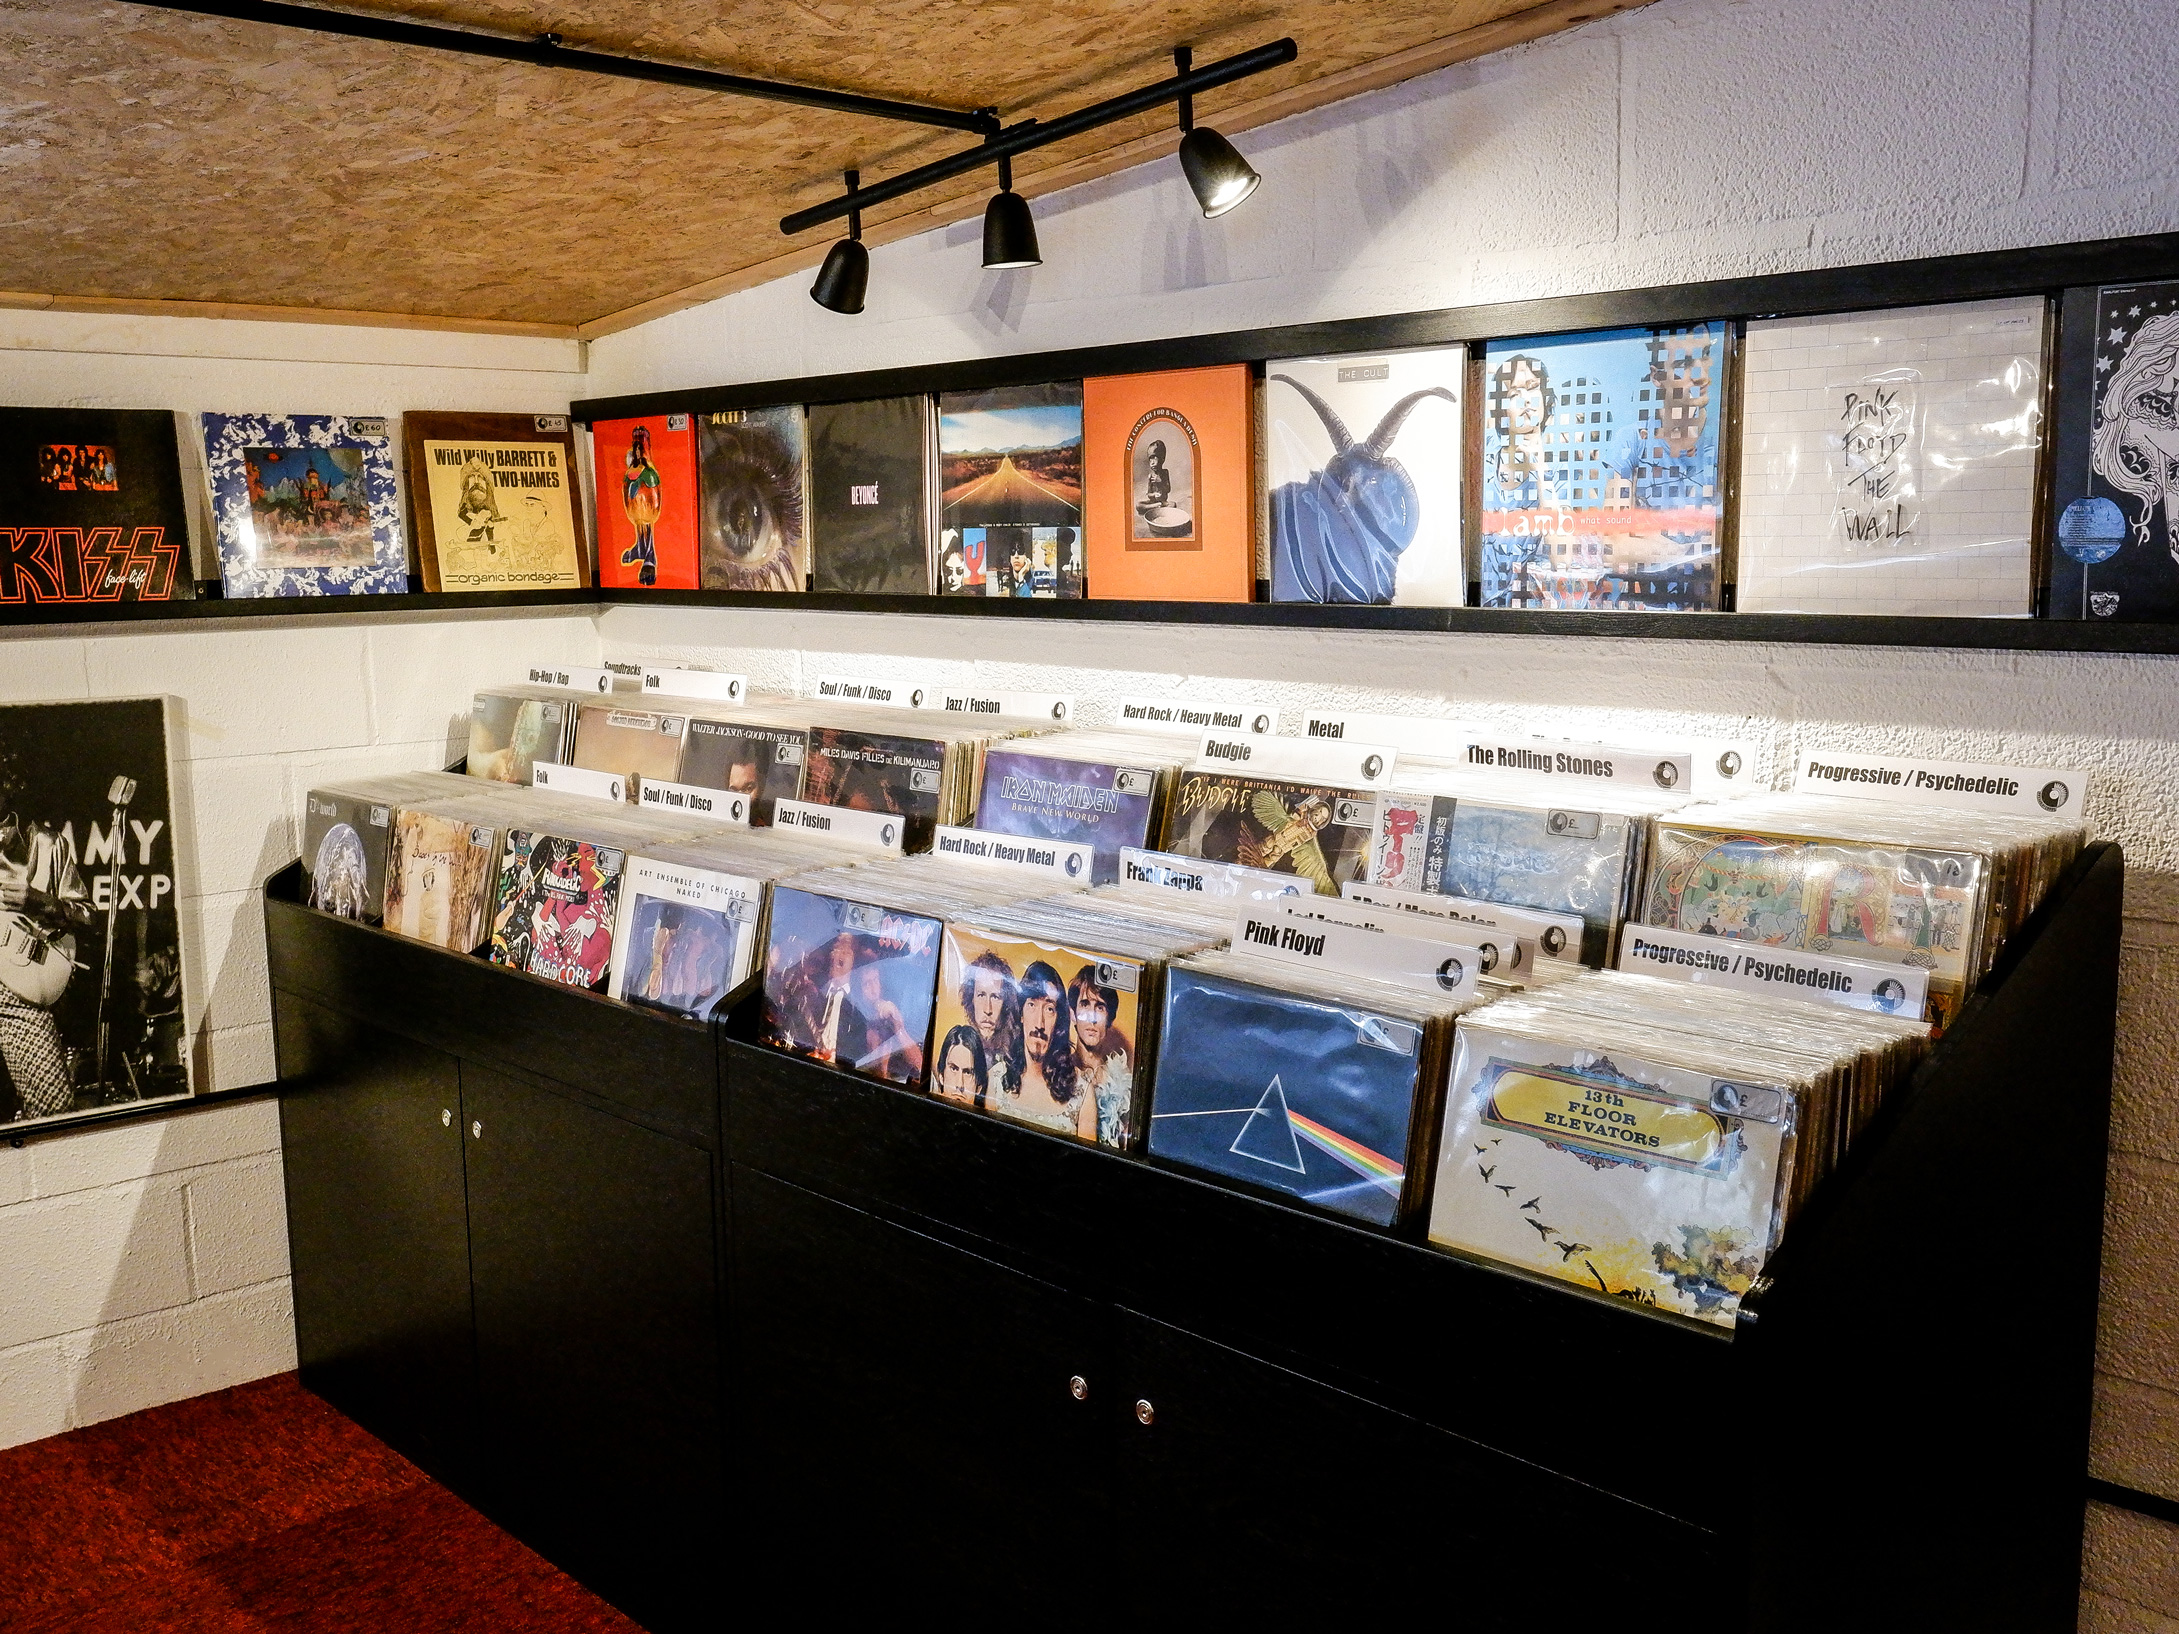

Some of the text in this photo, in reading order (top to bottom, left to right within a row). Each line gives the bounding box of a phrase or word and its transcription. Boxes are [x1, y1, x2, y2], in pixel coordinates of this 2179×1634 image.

[1339, 367, 1389, 379] THE CULT
[740, 410, 747, 423] 3
[1841, 386, 1898, 426] PINK
[434, 448, 462, 466] Wild
[495, 450, 546, 468] BARRETT
[548, 450, 557, 468] &
[491, 470, 560, 488] TWO-NAMES
[1848, 462, 1895, 502] THE
[851, 480, 879, 505] BEYONCÉ
[1498, 506, 1632, 537] lamb what sound
[1841, 504, 1910, 541] WALL
[0, 527, 180, 603] KISS
[458, 571, 560, 586] organic bondage
[529, 669, 553, 683] Hip-Hop
[557, 672, 569, 686] Rap
[604, 660, 642, 676] Soundtracks
[645, 675, 660, 688] Folk
[819, 682, 836, 696] Soul
[843, 684, 861, 698] Funk
[868, 687, 891, 701] Disco
[945, 696, 963, 711] Jazz
[970, 698, 1000, 714] Fusion
[1123, 704, 1147, 719] Hard
[1149, 707, 1172, 722] Rock
[1180, 710, 1211, 726] Heavy
[1212, 712, 1243, 728] Metal
[1308, 719, 1345, 738] Metal
[820, 747, 840, 758] MILES
[841, 750, 860, 760] DAVIS
[861, 752, 884, 763] FILLES
[893, 755, 940, 770] KILIMANJARO
[1205, 740, 1251, 761] Budgie
[1467, 744, 1613, 777] The Rolling Stones
[536, 769, 548, 785] Folk
[1221, 778, 1240, 787] WERE
[1327, 790, 1341, 798] THE
[1808, 761, 1901, 788] Progressive
[1915, 770, 2019, 797] Psychedelic
[643, 786, 660, 802] Soul
[666, 790, 684, 807] Funk
[690, 794, 712, 812] Disco
[1001, 776, 1120, 813] IRON MAIDEN
[778, 807, 795, 824] Jazz
[802, 812, 831, 831] Fusion
[1011, 802, 1038, 814] BRAVE
[1065, 810, 1099, 823] WORLD
[940, 836, 962, 853] Hard
[963, 839, 986, 857] Rock
[995, 843, 1025, 863] Heavy
[1026, 847, 1056, 867] Metal
[639, 869, 746, 898] ART ENSEMBLE OF CHICAGO
[1126, 861, 1203, 891] Frank Zappa
[92, 874, 171, 911] EXP
[676, 888, 701, 899] NAKED
[1244, 920, 1280, 946] Pink
[1281, 928, 1326, 956] Floyd
[1632, 938, 1729, 974] Progressive
[1743, 957, 1853, 994] Psychedelic
[1584, 1089, 1624, 1108] 13th
[1568, 1101, 1636, 1126] FLOOR
[1544, 1112, 1660, 1148] ELEVATORS
